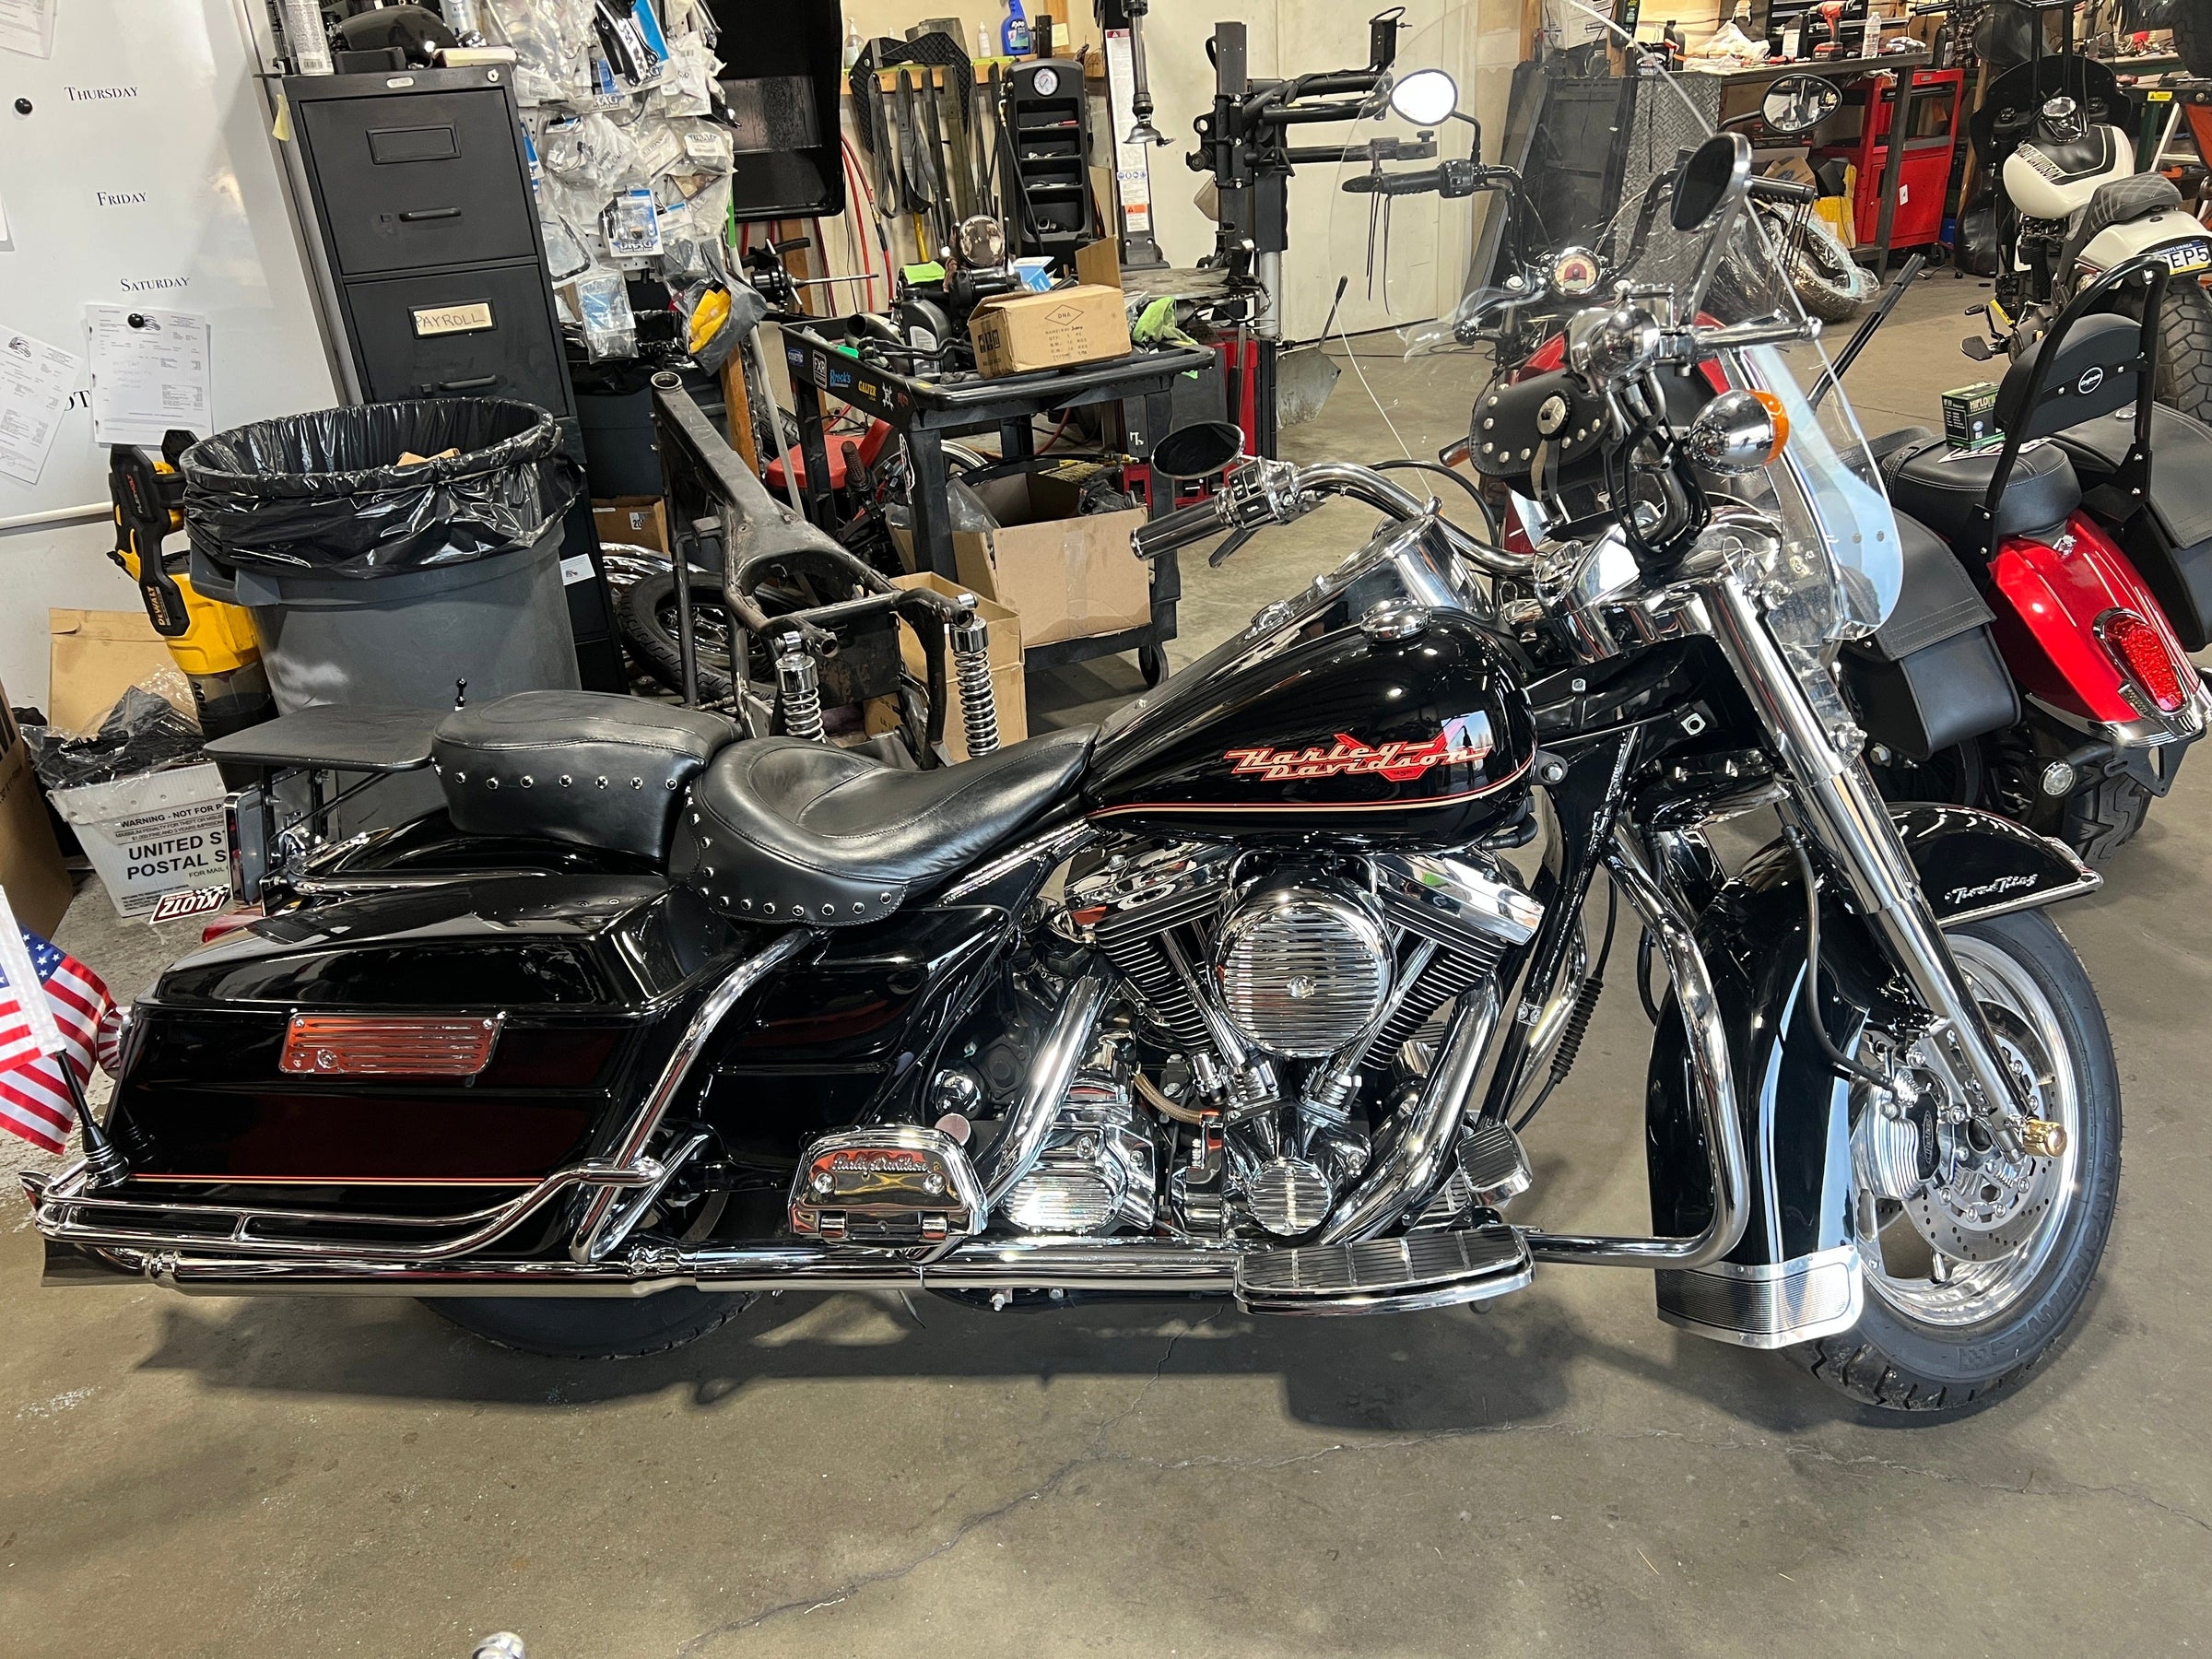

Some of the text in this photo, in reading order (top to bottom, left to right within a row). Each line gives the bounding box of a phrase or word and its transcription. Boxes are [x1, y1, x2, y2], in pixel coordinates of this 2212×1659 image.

[65, 87, 138, 101] THURSDAY
[594, 94, 619, 108] RAG
[97, 192, 147, 206] FRIDAY
[2163, 246, 2210, 269] EP5
[120, 277, 191, 292] SATURDAY
[415, 312, 486, 328] PAYROLL
[1057, 312, 1071, 320] DNA
[147, 585, 166, 627] DEWALT
[1224, 739, 1437, 768] Harley
[1259, 748, 1492, 782] Davidson
[121, 815, 165, 828] WARNING
[172, 809, 192, 819] NOT
[194, 806, 214, 815] FOR
[129, 830, 225, 861] UNITED S
[127, 850, 227, 880] POSTAL S
[188, 866, 224, 878] FOR MAIL
[158, 893, 219, 918] KLOTZ
